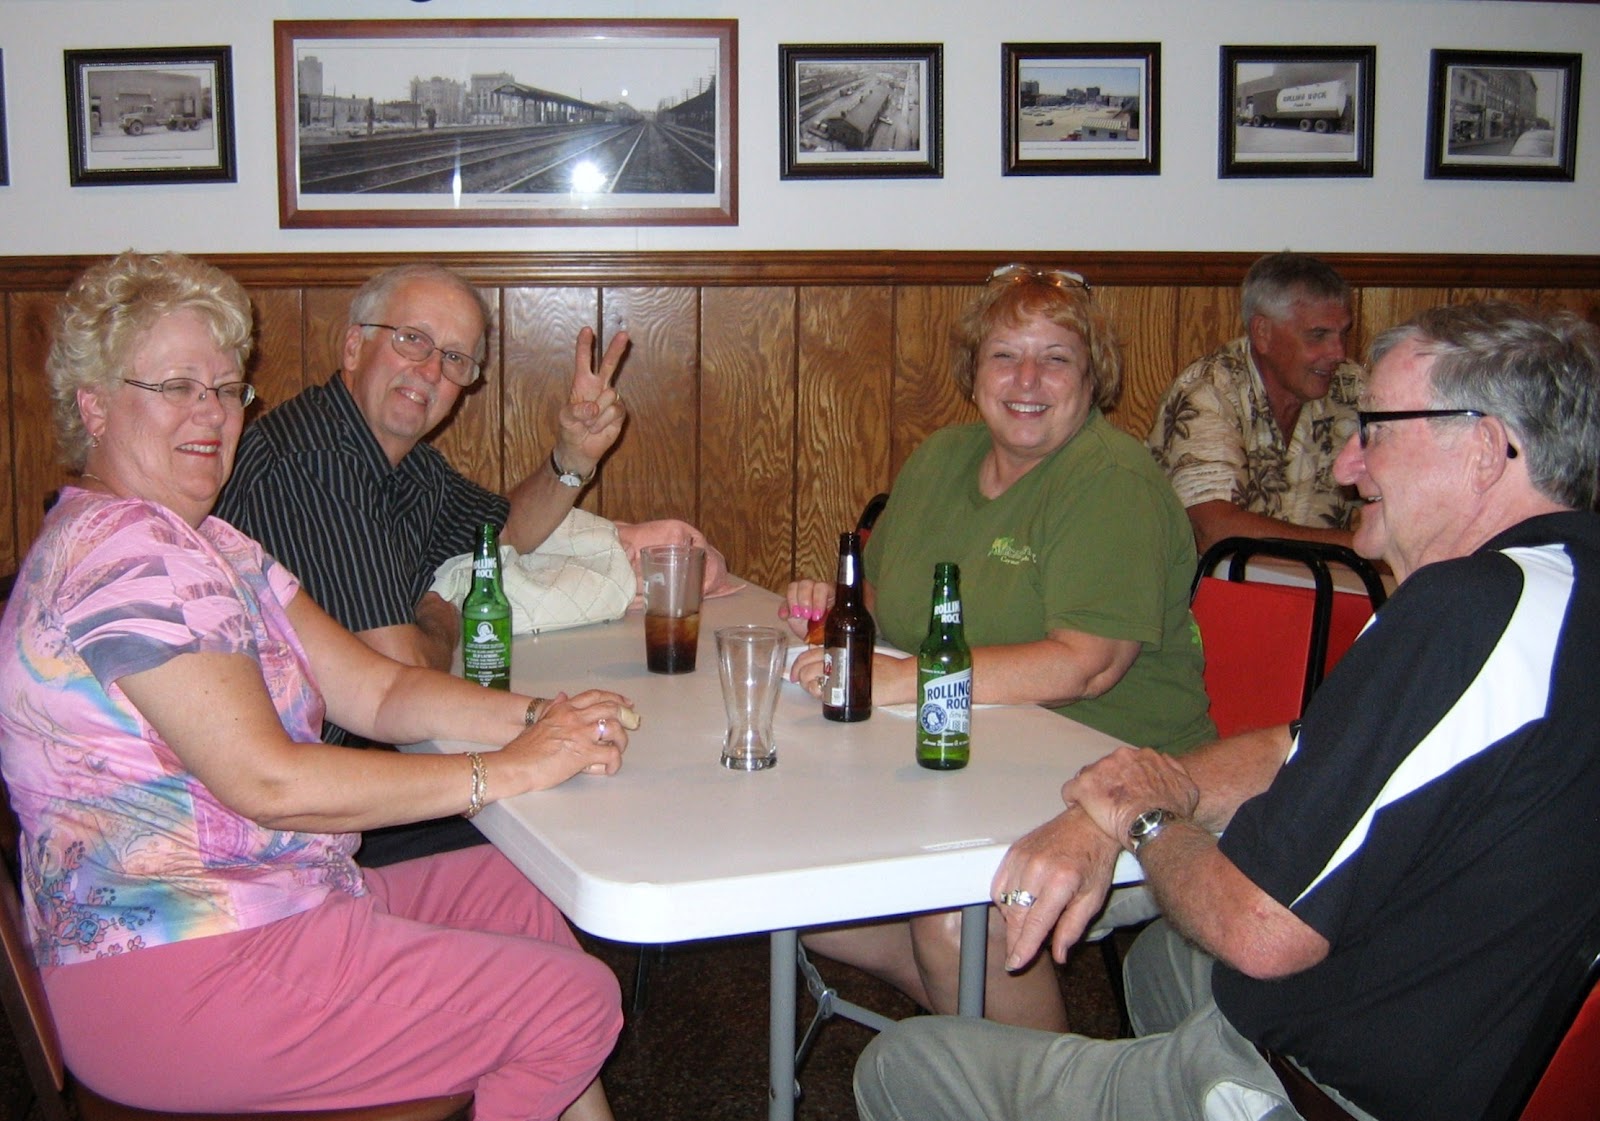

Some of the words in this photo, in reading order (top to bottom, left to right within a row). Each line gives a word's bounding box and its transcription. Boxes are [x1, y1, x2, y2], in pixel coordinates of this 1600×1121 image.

[473, 557, 497, 569] OLLING
[475, 569, 496, 579] ROCK
[934, 600, 961, 615] ROLLIN
[927, 679, 970, 701] ROLLING
